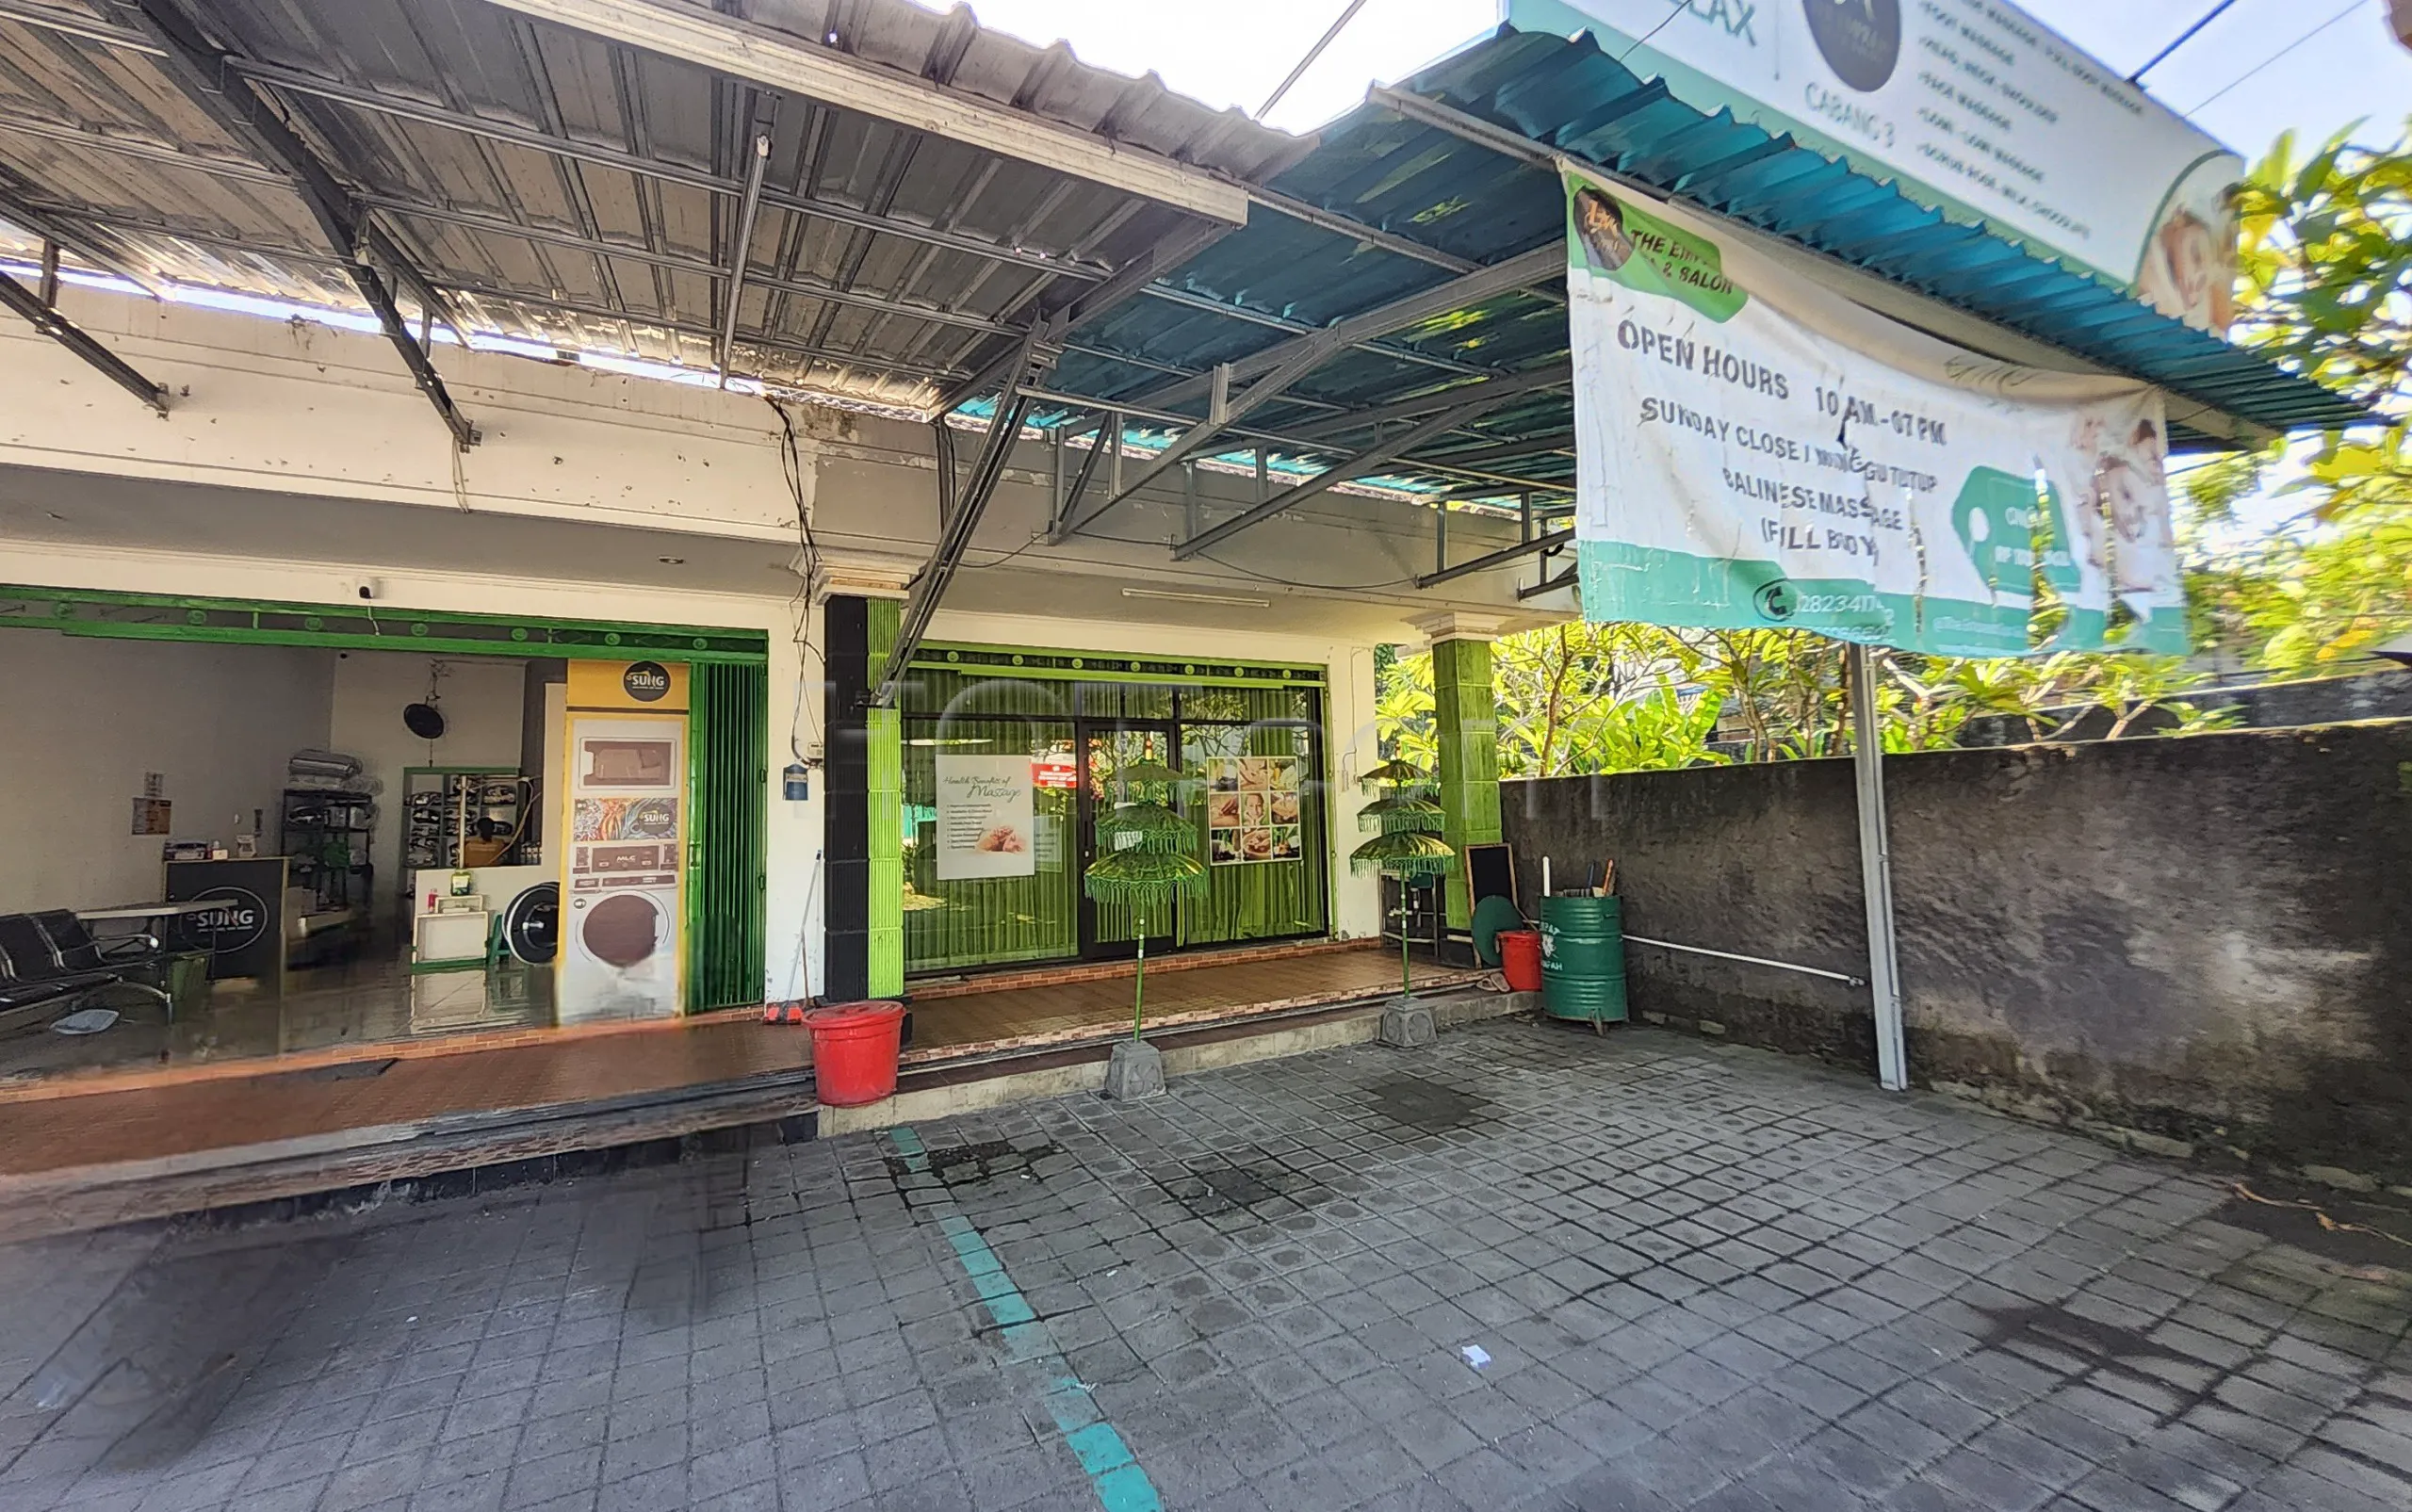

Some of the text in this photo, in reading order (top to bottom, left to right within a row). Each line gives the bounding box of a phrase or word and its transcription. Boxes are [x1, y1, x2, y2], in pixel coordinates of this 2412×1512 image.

[1669, 0, 1757, 47] LAX
[1631, 229, 1666, 253] THE
[1618, 319, 1694, 369] OPEN
[1703, 346, 1789, 399] HOURS
[1816, 386, 1838, 416] 10
[1640, 397, 1730, 442] SUNDAY
[1736, 426, 1801, 461] CLOSE
[1722, 467, 1817, 509] BALINESE
[632, 675, 664, 687] SUNG
[644, 813, 670, 823] SUNG
[197, 909, 254, 927] SUNG
